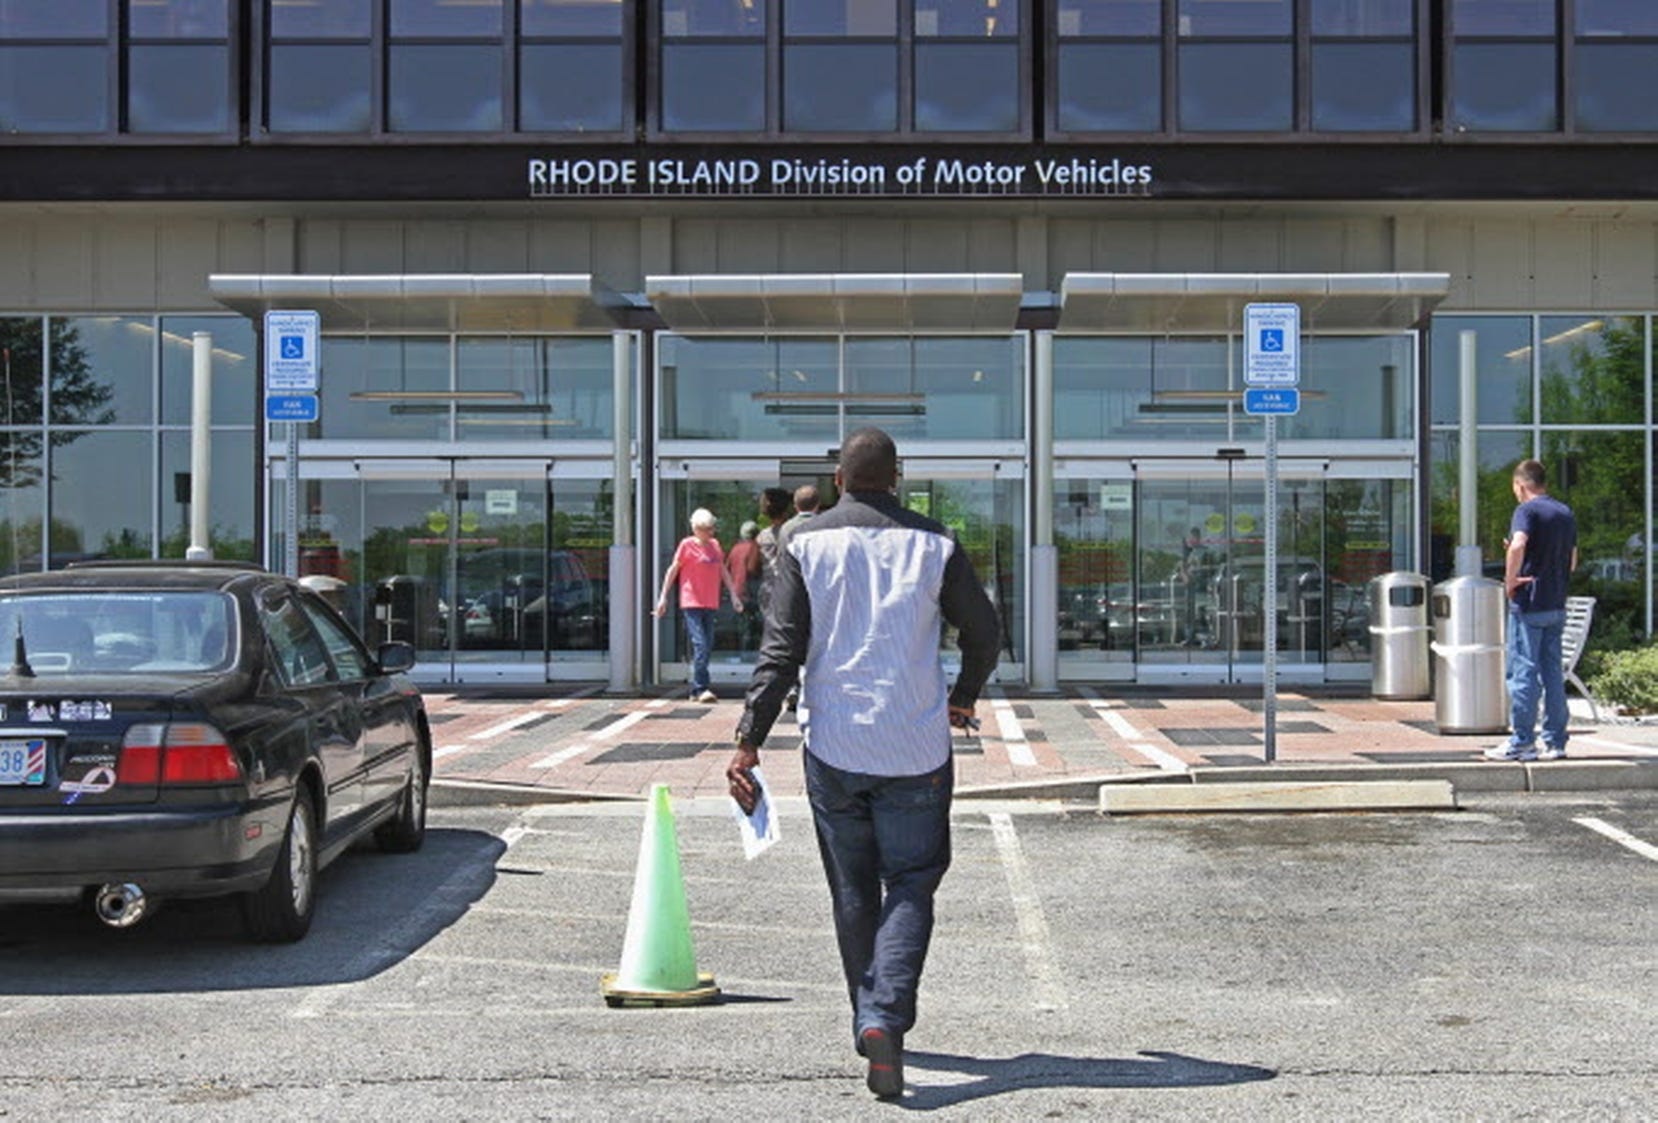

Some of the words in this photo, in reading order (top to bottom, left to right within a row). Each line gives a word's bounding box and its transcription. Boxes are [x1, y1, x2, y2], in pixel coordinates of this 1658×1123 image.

[528, 159, 636, 184] RHODE
[647, 159, 760, 184] ISLAND
[770, 158, 885, 184] Division
[895, 157, 926, 184] of
[933, 159, 1026, 184] Motor
[1034, 158, 1152, 184] Vehicles
